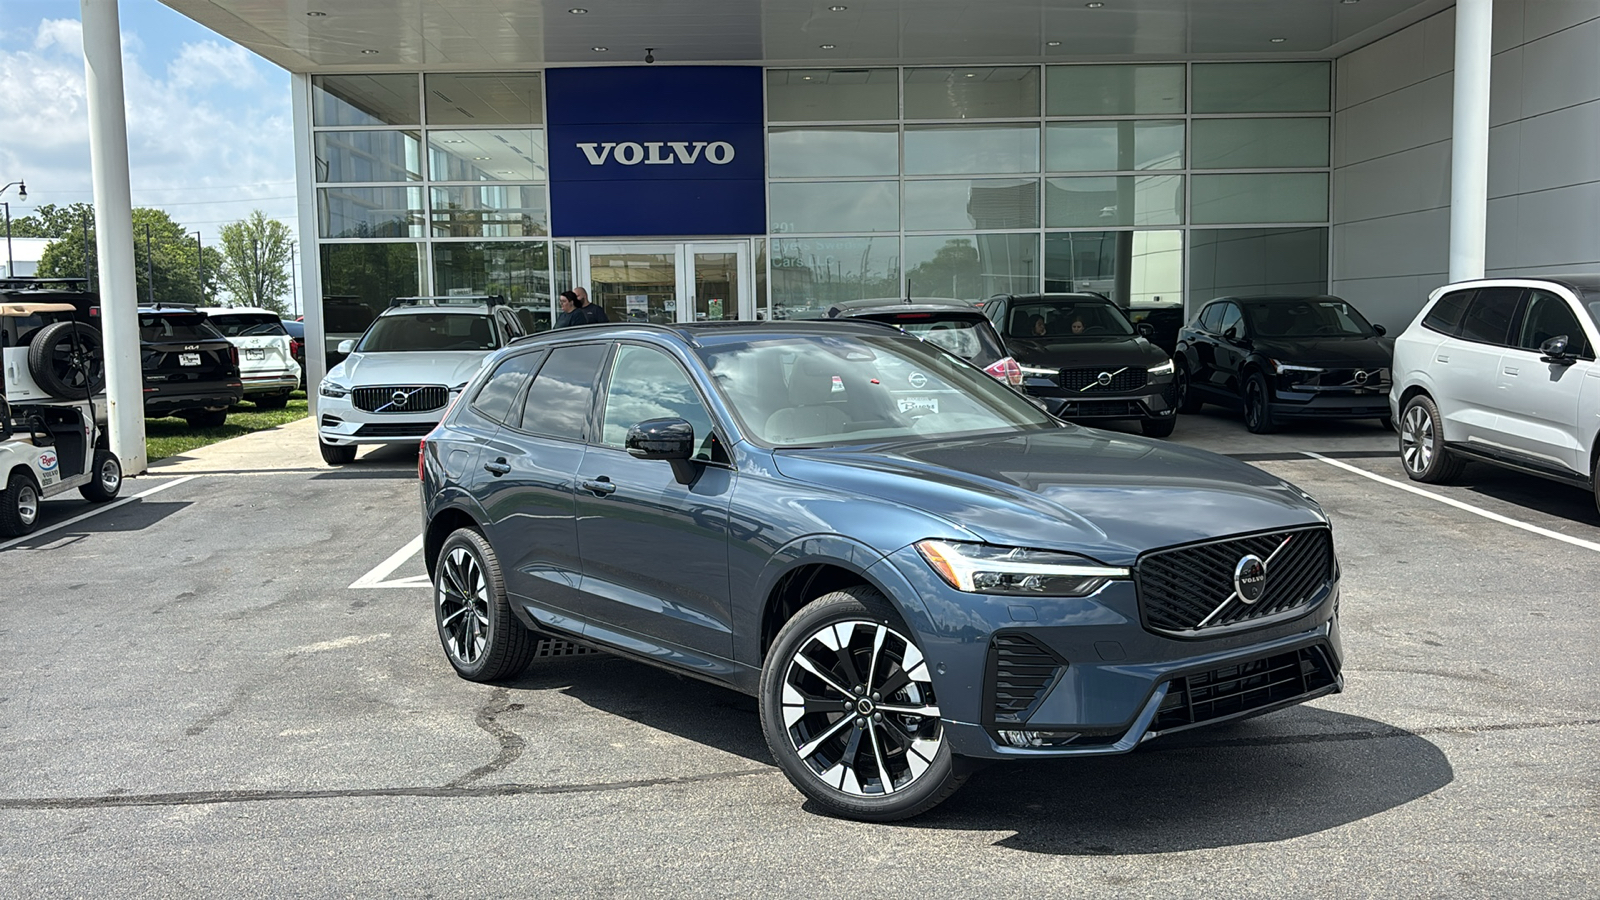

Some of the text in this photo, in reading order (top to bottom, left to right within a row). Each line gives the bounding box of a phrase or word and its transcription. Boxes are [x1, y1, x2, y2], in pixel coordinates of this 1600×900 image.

[576, 141, 735, 165] VOLVO
[772, 255, 834, 267] Cars LLC
[42, 470, 58, 478] VOLVO
[1241, 575, 1264, 584] VOLVO
